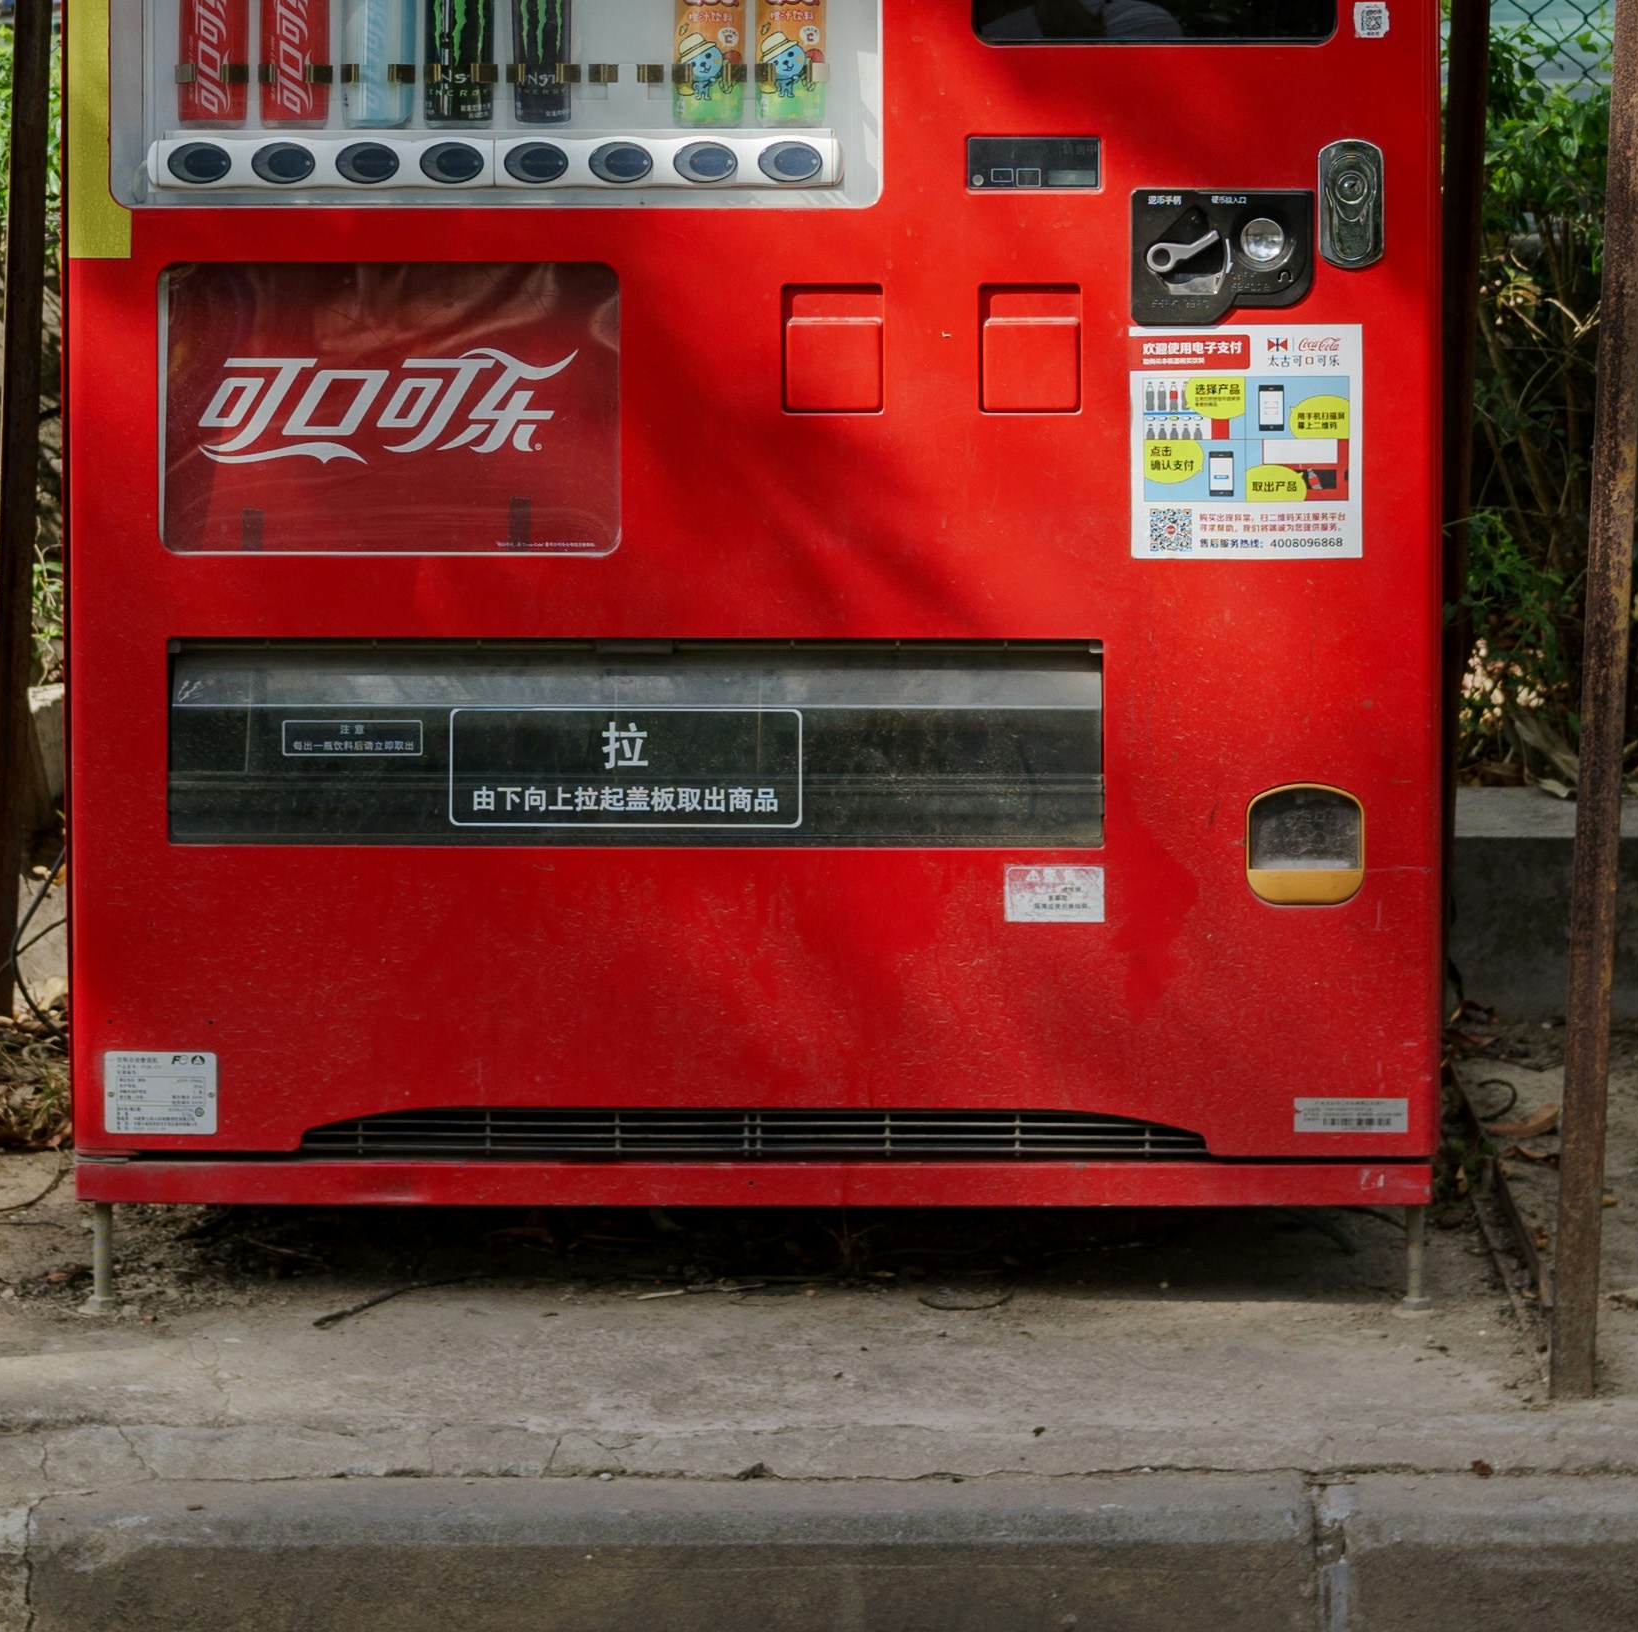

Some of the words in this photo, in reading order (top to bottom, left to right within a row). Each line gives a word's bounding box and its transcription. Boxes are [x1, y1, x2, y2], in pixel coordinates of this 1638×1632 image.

[688, 10, 733, 23] 橙汁饮料
[769, 9, 815, 23] 橙汁饮料
[1143, 341, 1243, 356] 欢迎使用电子支付
[1268, 355, 1340, 368] 太古可口可乐
[1195, 383, 1241, 396] 选择产品
[197, 347, 579, 465] 可口可乐
[1150, 446, 1172, 457] 点击
[1150, 459, 1195, 472] 确认支付
[1251, 481, 1298, 492] 取出产品
[1270, 537, 1344, 549] 4008096868
[292, 741, 414, 751] 每出一瓶饮料后请立即取出
[601, 721, 649, 770] 拉
[471, 785, 778, 813] 由下向上拉起盖板取出商品
